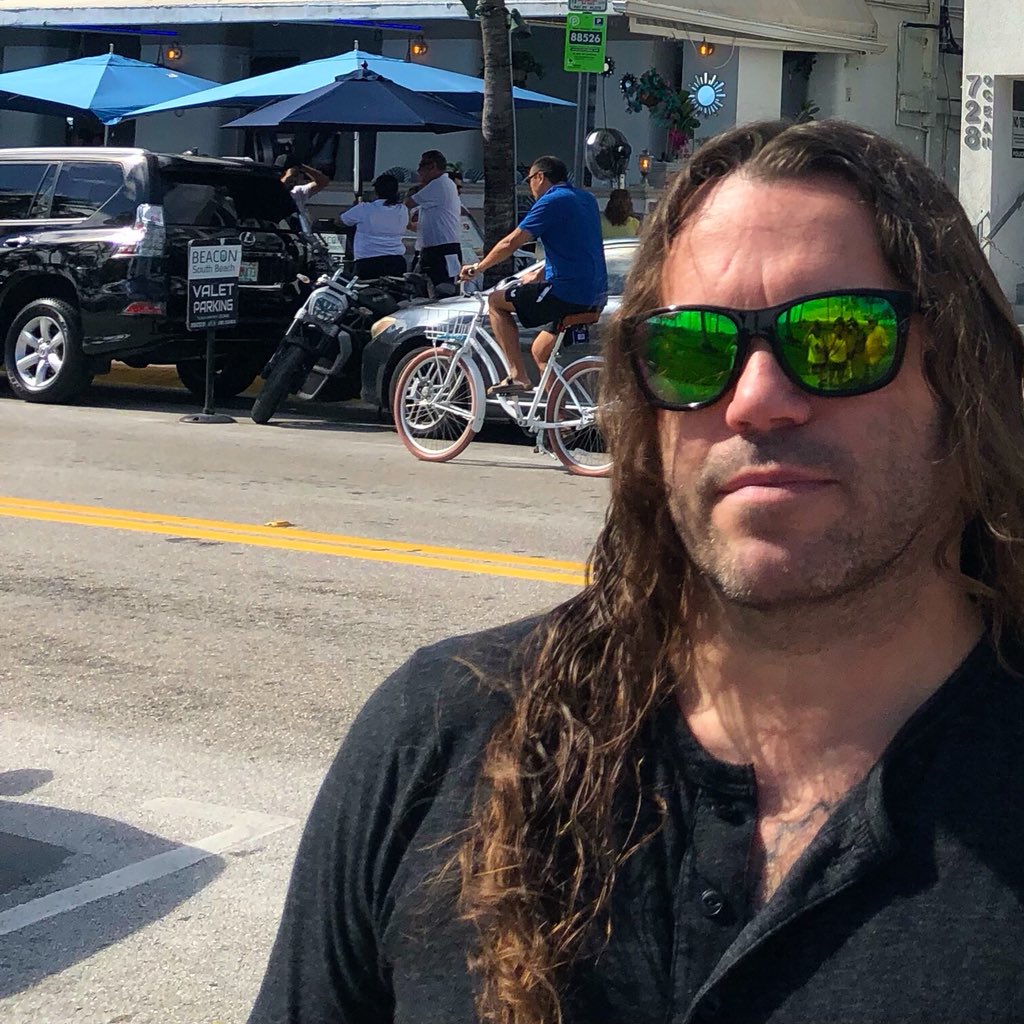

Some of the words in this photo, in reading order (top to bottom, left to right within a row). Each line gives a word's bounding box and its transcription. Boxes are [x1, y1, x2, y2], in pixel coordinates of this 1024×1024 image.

[570, 32, 601, 43] 88526
[964, 74, 982, 151] 728
[192, 250, 238, 264] BEACON
[192, 265, 213, 274] South
[215, 264, 236, 273] Beach
[193, 283, 235, 298] VALET
[193, 299, 234, 314] PARKING
